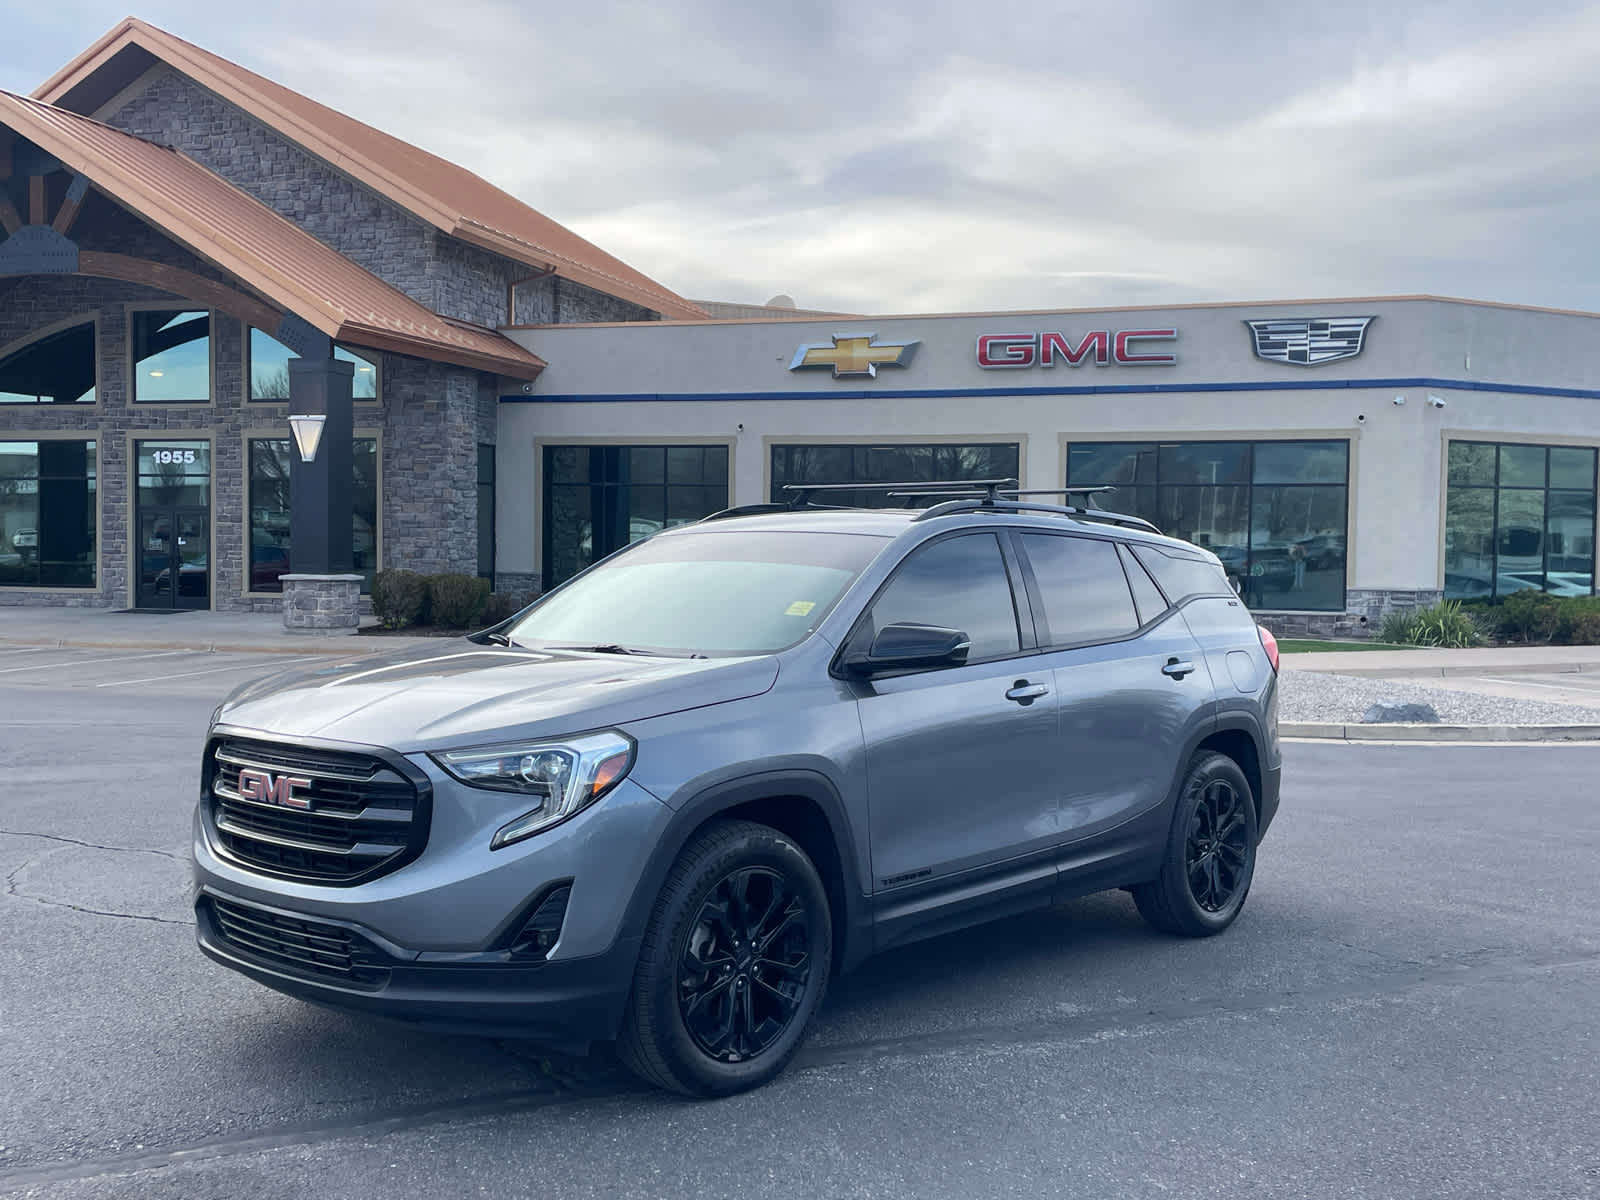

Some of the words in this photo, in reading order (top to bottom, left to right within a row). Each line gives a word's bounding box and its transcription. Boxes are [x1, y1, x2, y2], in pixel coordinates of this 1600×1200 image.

[976, 328, 1177, 369] GMC
[152, 450, 196, 465] 1955
[238, 768, 312, 809] GMC
